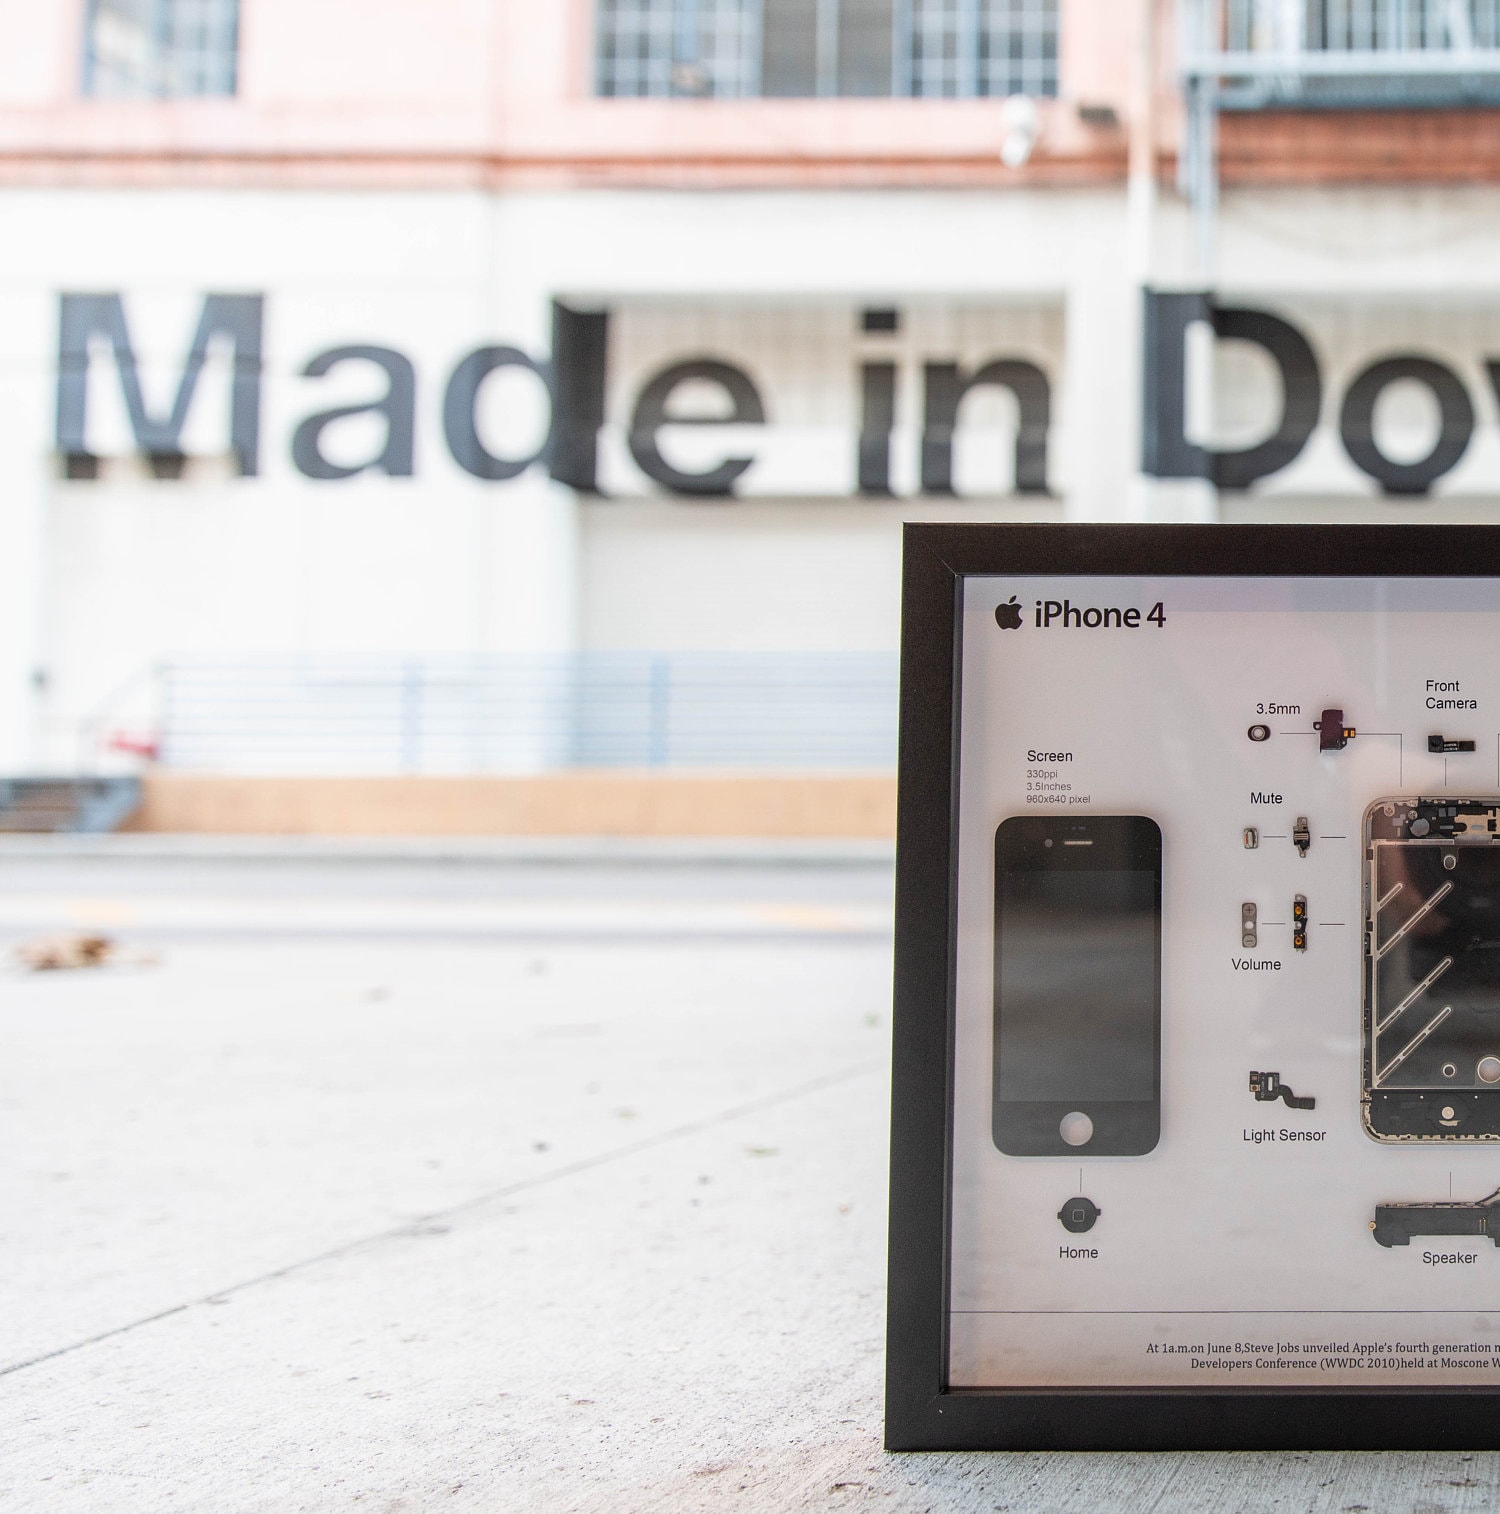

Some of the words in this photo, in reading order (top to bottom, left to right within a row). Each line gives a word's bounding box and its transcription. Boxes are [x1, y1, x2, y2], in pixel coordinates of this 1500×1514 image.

[55, 290, 767, 496] Made
[855, 306, 1056, 497] in
[1035, 600, 1142, 628] iPhone
[1146, 602, 1167, 627] 4
[1426, 680, 1460, 691] Front
[1256, 703, 1301, 714] 3.5mm
[1425, 697, 1478, 709] Camera
[1026, 750, 1073, 762] Screen
[1026, 770, 1058, 780] 330ppi
[1026, 795, 1067, 803] 960x640
[1069, 795, 1091, 806] pixel
[1250, 792, 1283, 804] Mute
[1231, 958, 1282, 970] Volume
[1243, 1129, 1276, 1144] Light
[1279, 1129, 1327, 1141] Sensor
[1059, 1246, 1099, 1258] Home
[1422, 1252, 1479, 1266] Speaker
[1146, 1343, 1160, 1353] At
[1206, 1343, 1232, 1355] June
[1276, 1342, 1300, 1355] Jobs
[1302, 1342, 1350, 1353] unveiled
[1395, 1342, 1430, 1352] fourth
[1431, 1343, 1492, 1355] generation
[1191, 1358, 1253, 1371] Developers
[1255, 1358, 1318, 1368] Conference
[1320, 1358, 1365, 1371] (WWDC
[1426, 1359, 1439, 1368] at
[1440, 1358, 1490, 1368] Moscone
